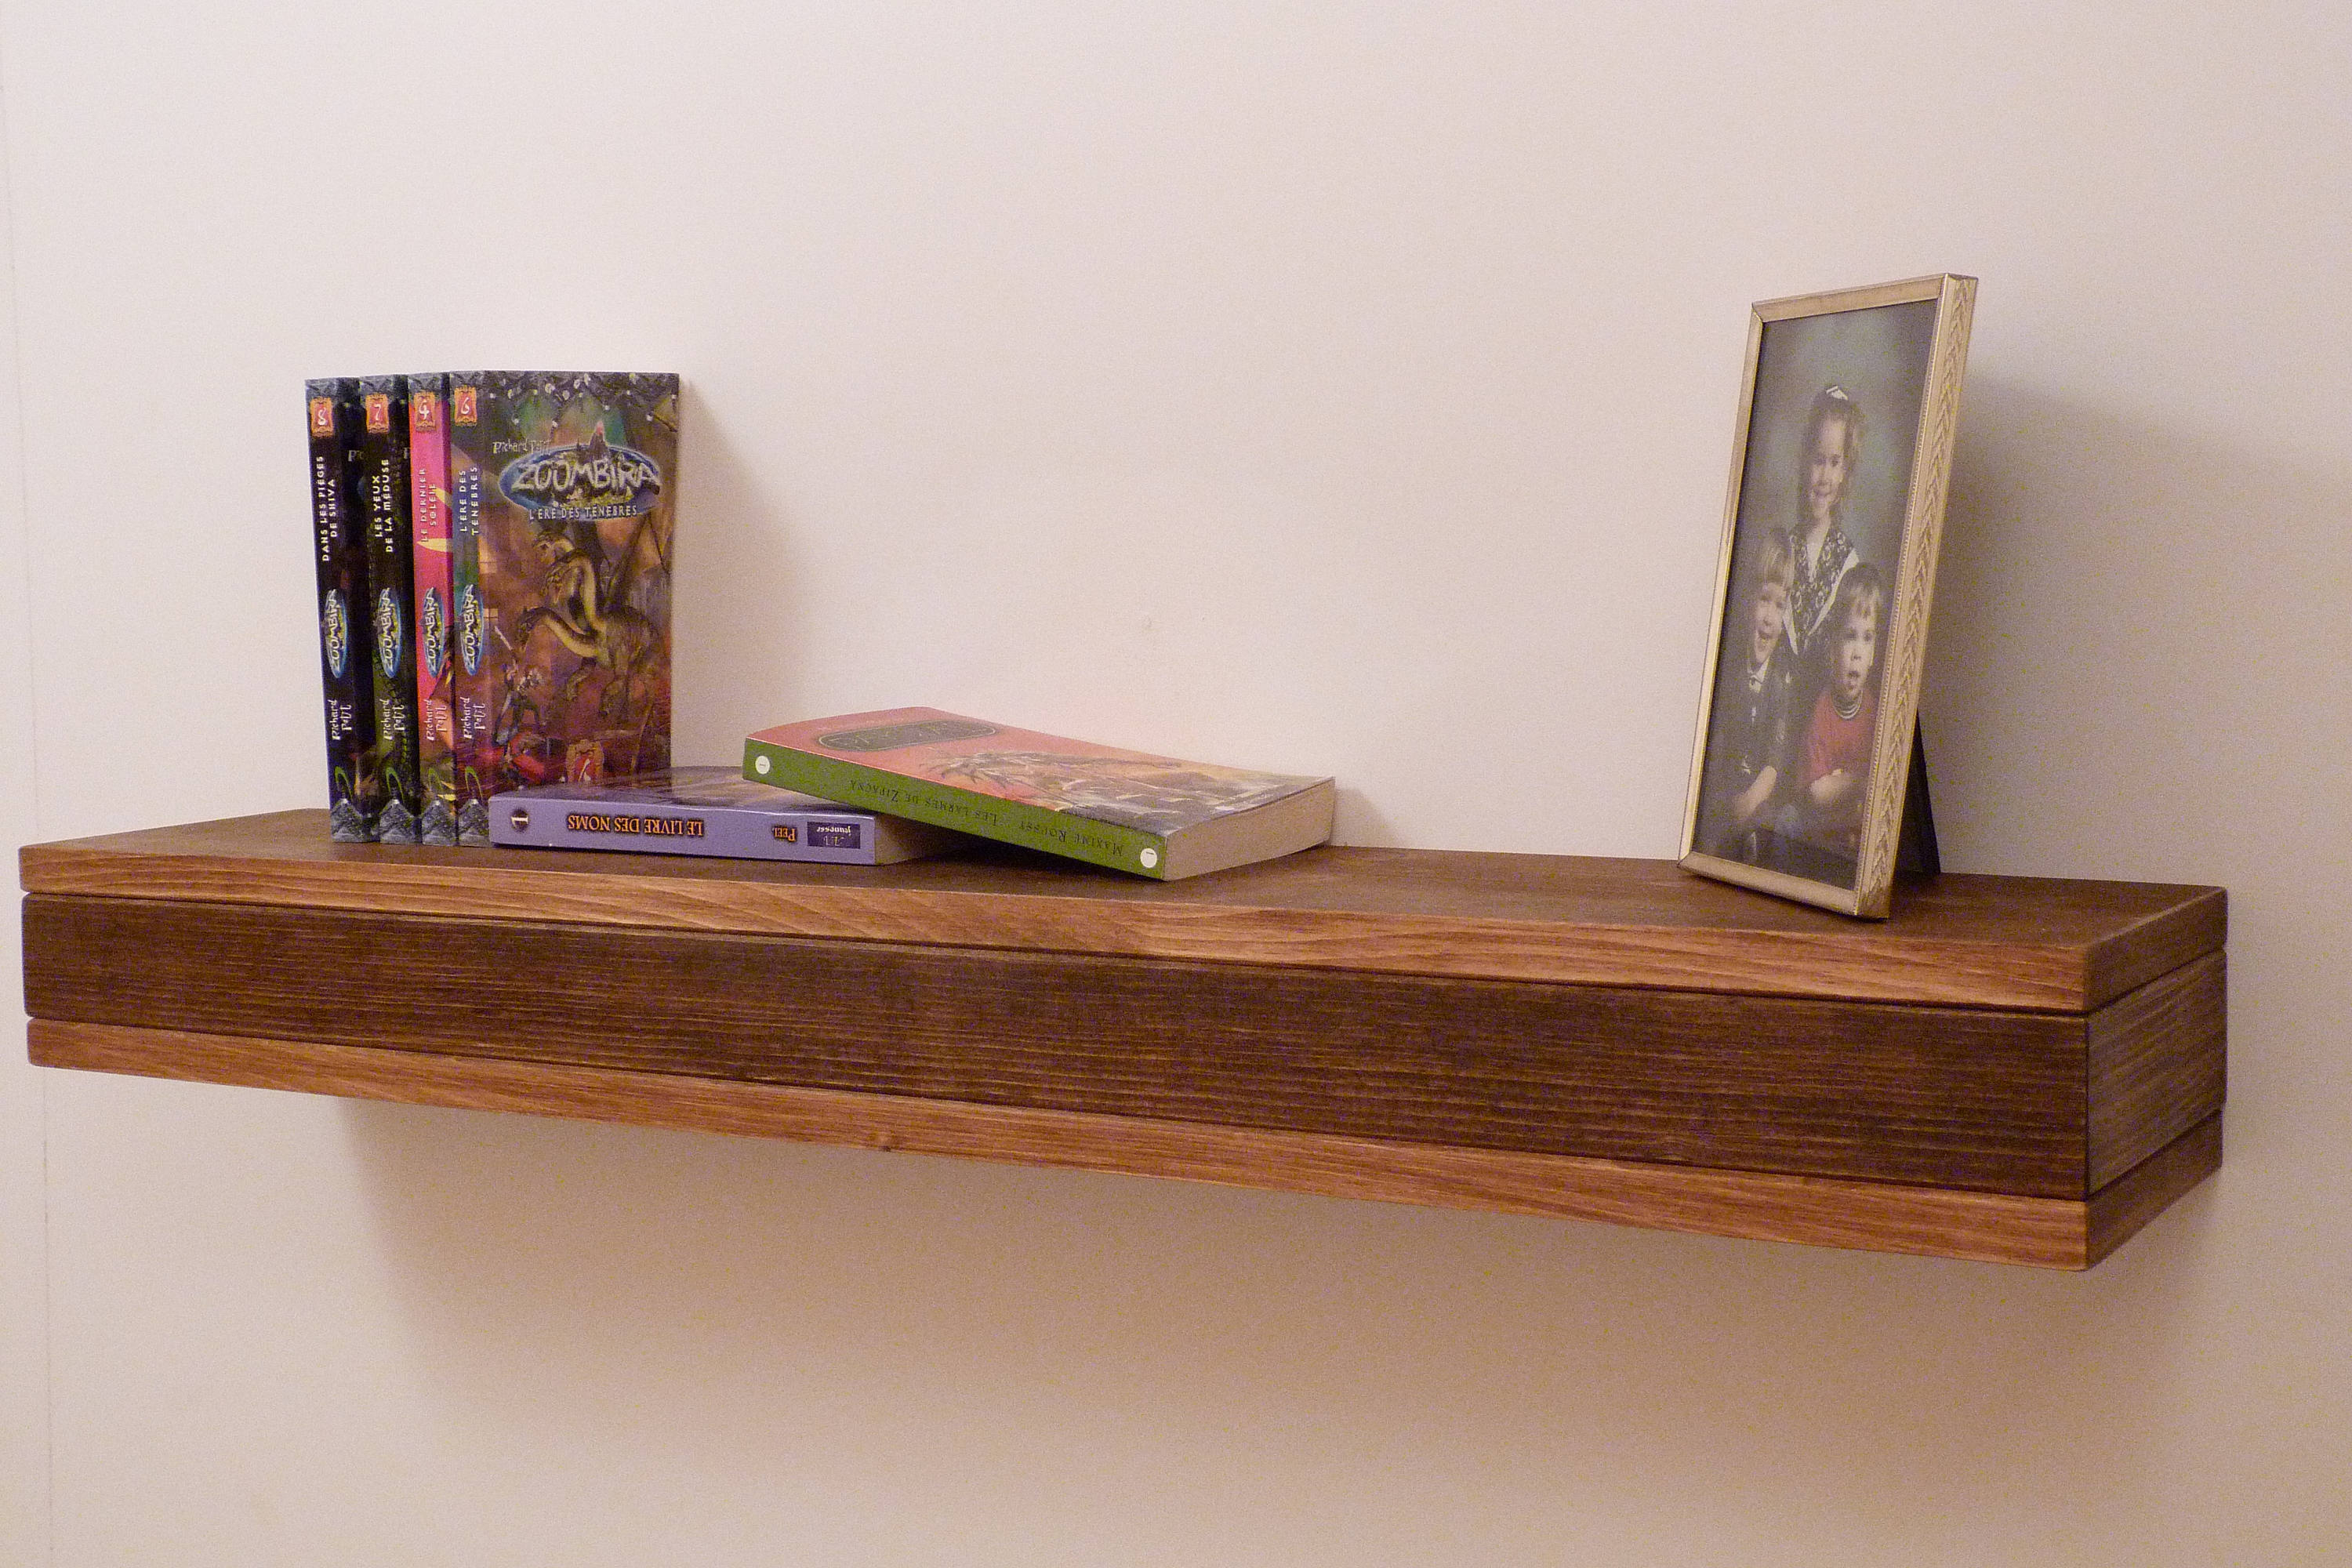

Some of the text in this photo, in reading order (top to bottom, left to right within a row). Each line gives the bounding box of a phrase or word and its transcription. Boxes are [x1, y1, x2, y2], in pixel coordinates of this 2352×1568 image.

[373, 403, 382, 422] 7
[419, 400, 430, 419] 4
[460, 396, 470, 415] 6
[318, 407, 328, 426] 8
[459, 470, 467, 492] DES
[510, 456, 662, 494] ZOOMBIRA
[319, 503, 328, 524] LES
[327, 479, 338, 538] DE SHIVA
[372, 475, 383, 538] LES YEUX
[419, 467, 430, 543] LE DERNIER
[428, 483, 437, 527] SOLEIL
[561, 506, 581, 519] DES
[383, 519, 393, 535] LA
[321, 528, 331, 562] DANS
[385, 538, 394, 553] DE
[567, 814, 703, 837] LE LIVRE DES NOMS
